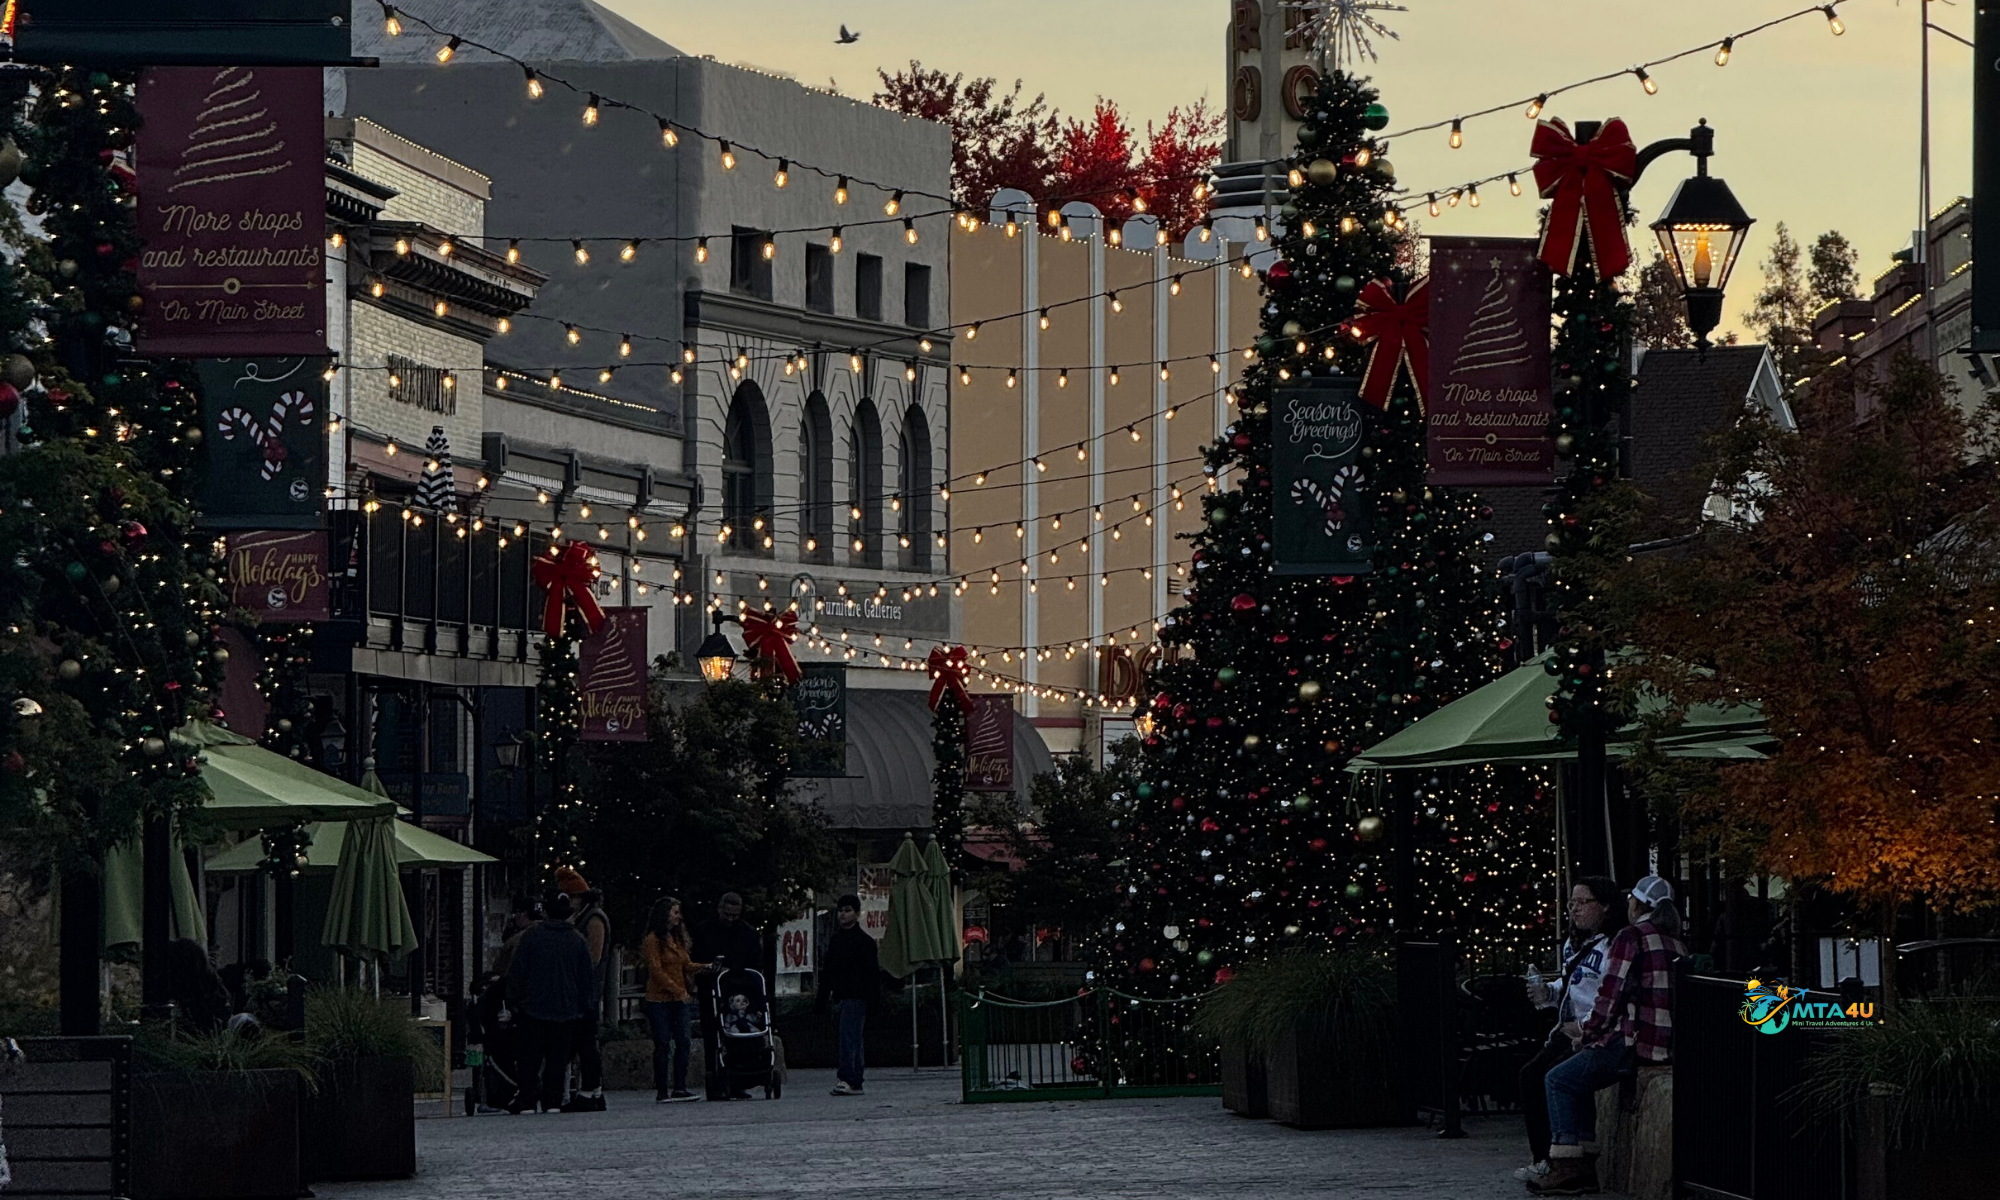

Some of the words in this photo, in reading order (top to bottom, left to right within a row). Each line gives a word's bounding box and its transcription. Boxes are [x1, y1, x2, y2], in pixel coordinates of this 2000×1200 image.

[158, 205, 232, 237] More
[239, 208, 303, 238] shops
[142, 246, 186, 267] and
[193, 244, 320, 267] restaurants
[160, 300, 191, 321] On
[196, 300, 249, 324] Main
[254, 299, 305, 321] Street
[1442, 383, 1492, 406] More
[1496, 387, 1538, 407] shops
[1283, 399, 1351, 423] Season's
[1431, 410, 1461, 426] and
[1465, 410, 1550, 427] restaurants
[1289, 420, 1359, 444] Greetings!
[1443, 447, 1464, 462] On
[1467, 447, 1503, 465] Main
[1505, 447, 1541, 462] Street
[291, 553, 319, 563] HAPPY
[229, 547, 325, 604] Holidays
[864, 598, 902, 620] Galleries
[581, 692, 645, 729] Holidays
